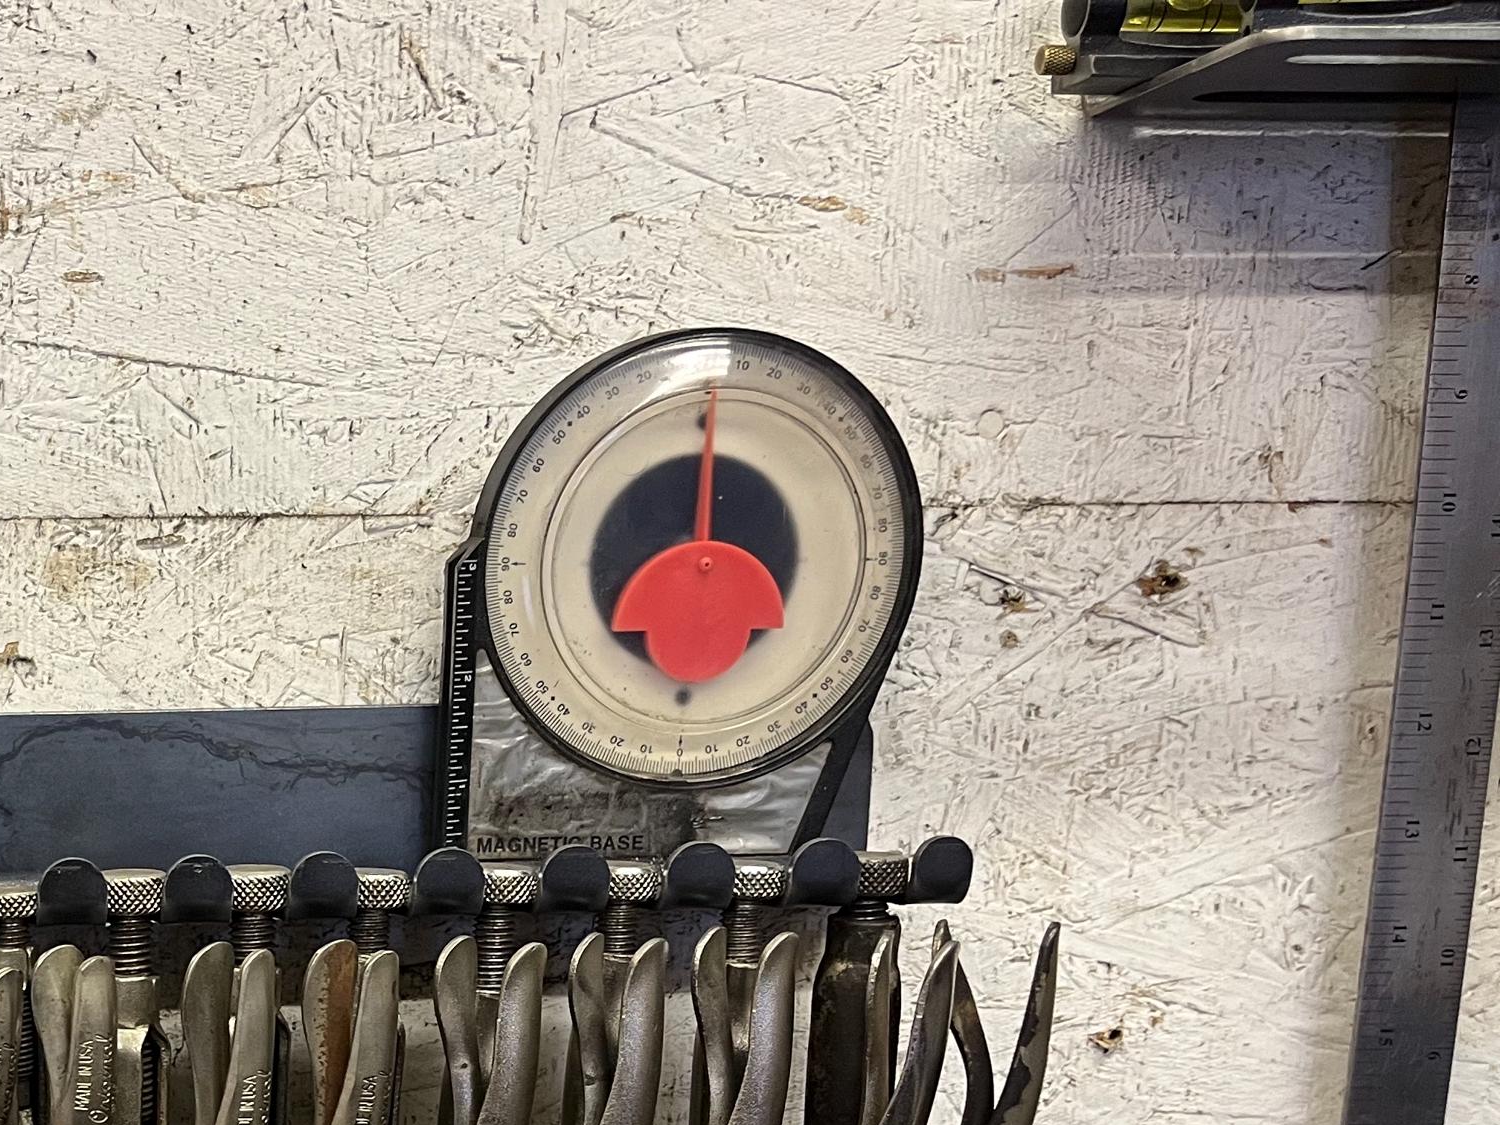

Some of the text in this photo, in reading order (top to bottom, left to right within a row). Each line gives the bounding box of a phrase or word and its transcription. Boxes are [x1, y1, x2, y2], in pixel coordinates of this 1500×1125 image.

[1464, 274, 1479, 286] 8
[735, 359, 750, 371] 10
[766, 366, 783, 380] 20
[636, 370, 652, 384] 20
[605, 386, 621, 400] 30
[1454, 388, 1468, 400] 9
[576, 405, 591, 420] 40
[552, 429, 566, 445] 50
[532, 457, 546, 474] 60
[516, 489, 529, 505] 70
[1442, 492, 1457, 512] 10
[507, 522, 519, 538] 80
[501, 556, 511, 572] 90
[878, 551, 888, 566] 90
[503, 589, 514, 605] 80
[1430, 603, 1445, 620] 11
[509, 622, 520, 638] 70
[1479, 628, 1494, 648] 13
[557, 702, 571, 717] 40
[1418, 712, 1433, 731] 12
[610, 734, 625, 748] 20
[640, 743, 653, 754] 10
[704, 743, 719, 755] 10
[736, 734, 751, 748] 20
[1466, 736, 1481, 756] 12
[1405, 820, 1420, 839] 13
[590, 835, 644, 851] BASE
[1453, 846, 1469, 862] 11
[1392, 926, 1408, 943] 14
[1440, 948, 1456, 966] 10
[1379, 1028, 1394, 1047] 15
[78, 1041, 95, 1064] USA
[242, 1075, 258, 1100] USA
[361, 1075, 378, 1100] USA
